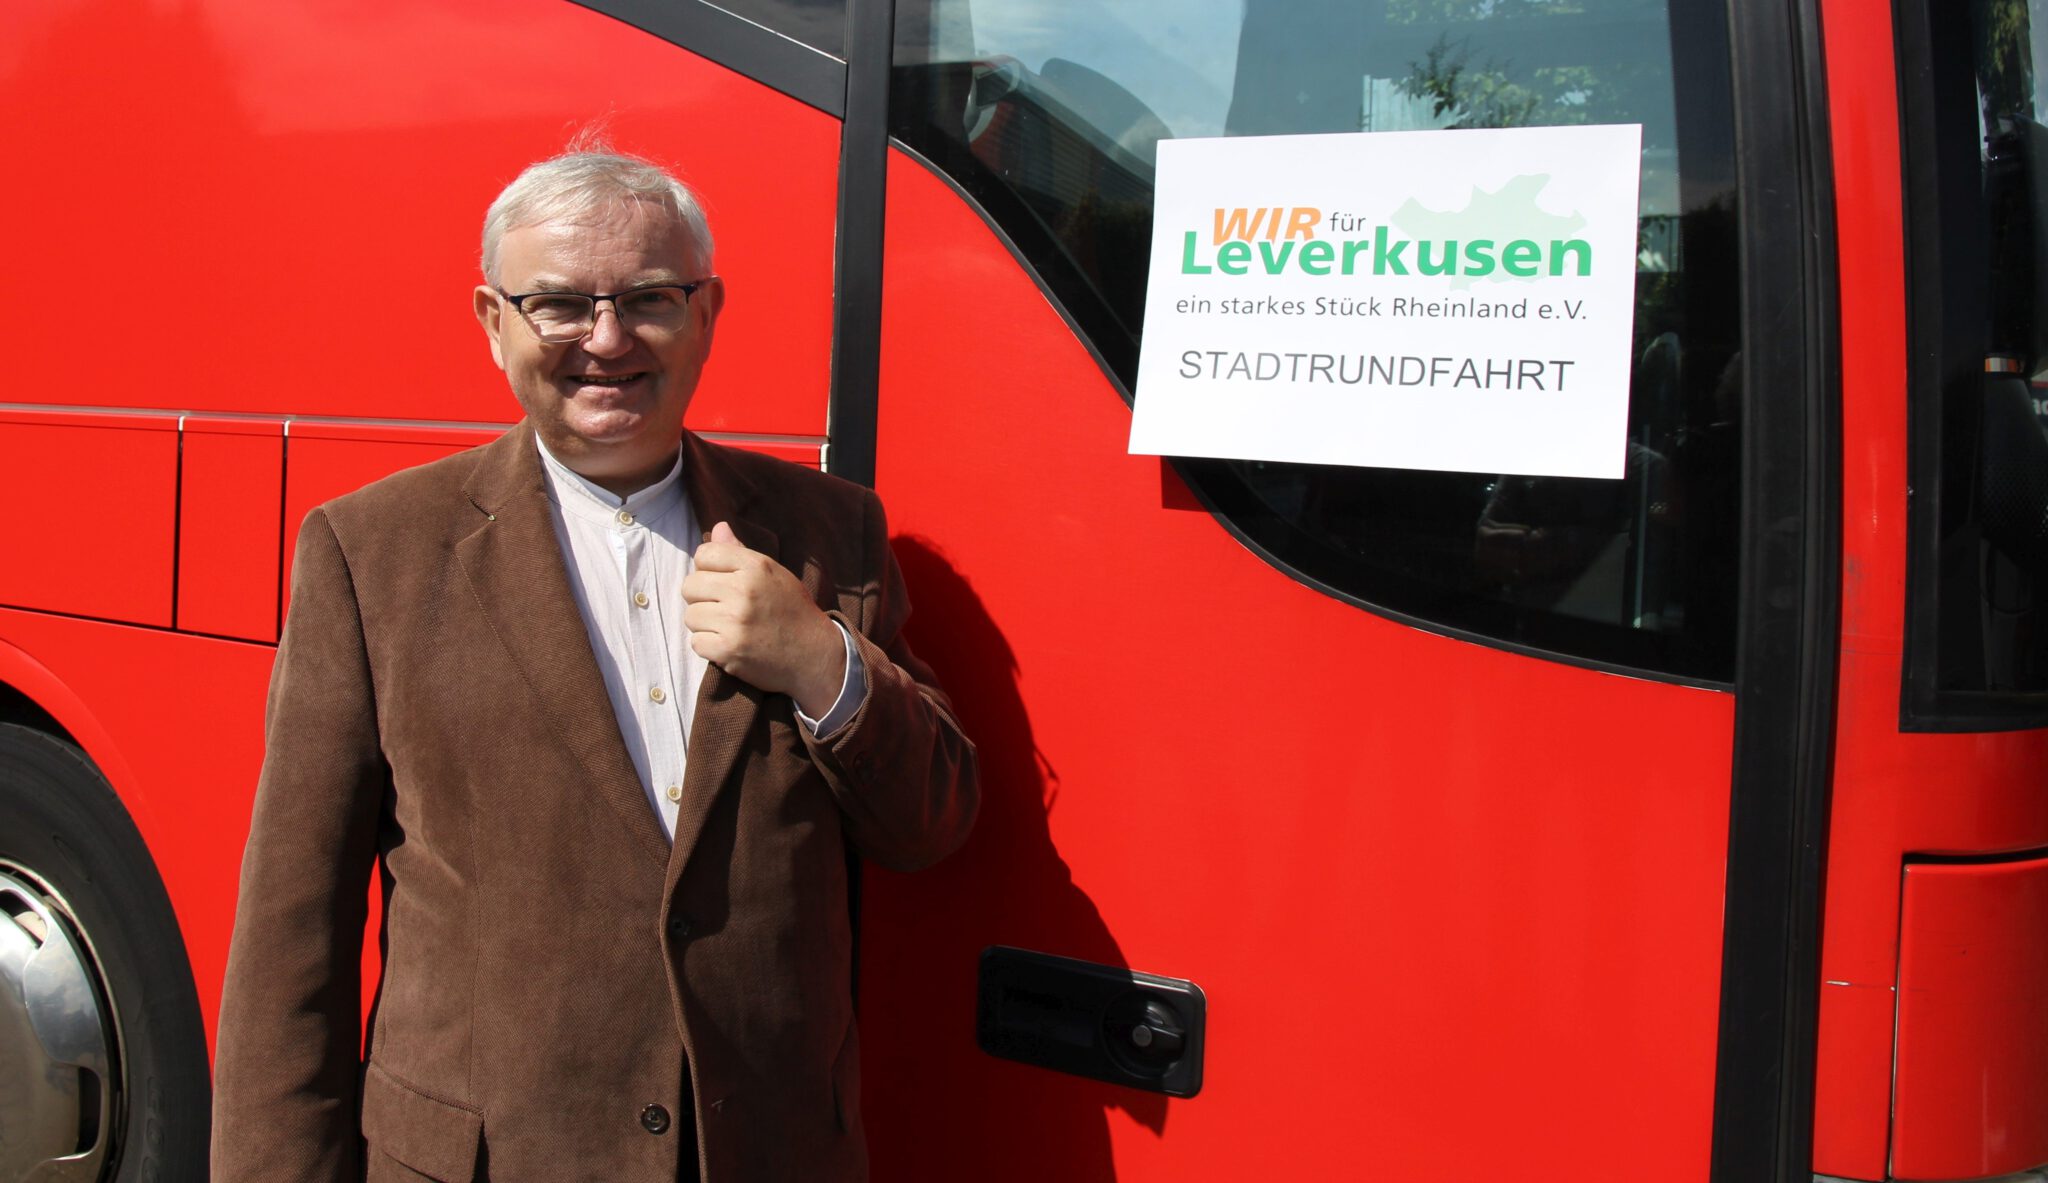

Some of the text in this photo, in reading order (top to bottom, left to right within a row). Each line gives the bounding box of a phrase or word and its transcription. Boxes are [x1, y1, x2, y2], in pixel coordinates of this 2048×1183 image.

[1213, 207, 1366, 245] WIR für
[1181, 226, 1591, 276] Leverkusen
[1176, 295, 1587, 320] ein starkes Stück Rheinland e.V.
[1179, 350, 1575, 391] STADTRUNDFAHRT
